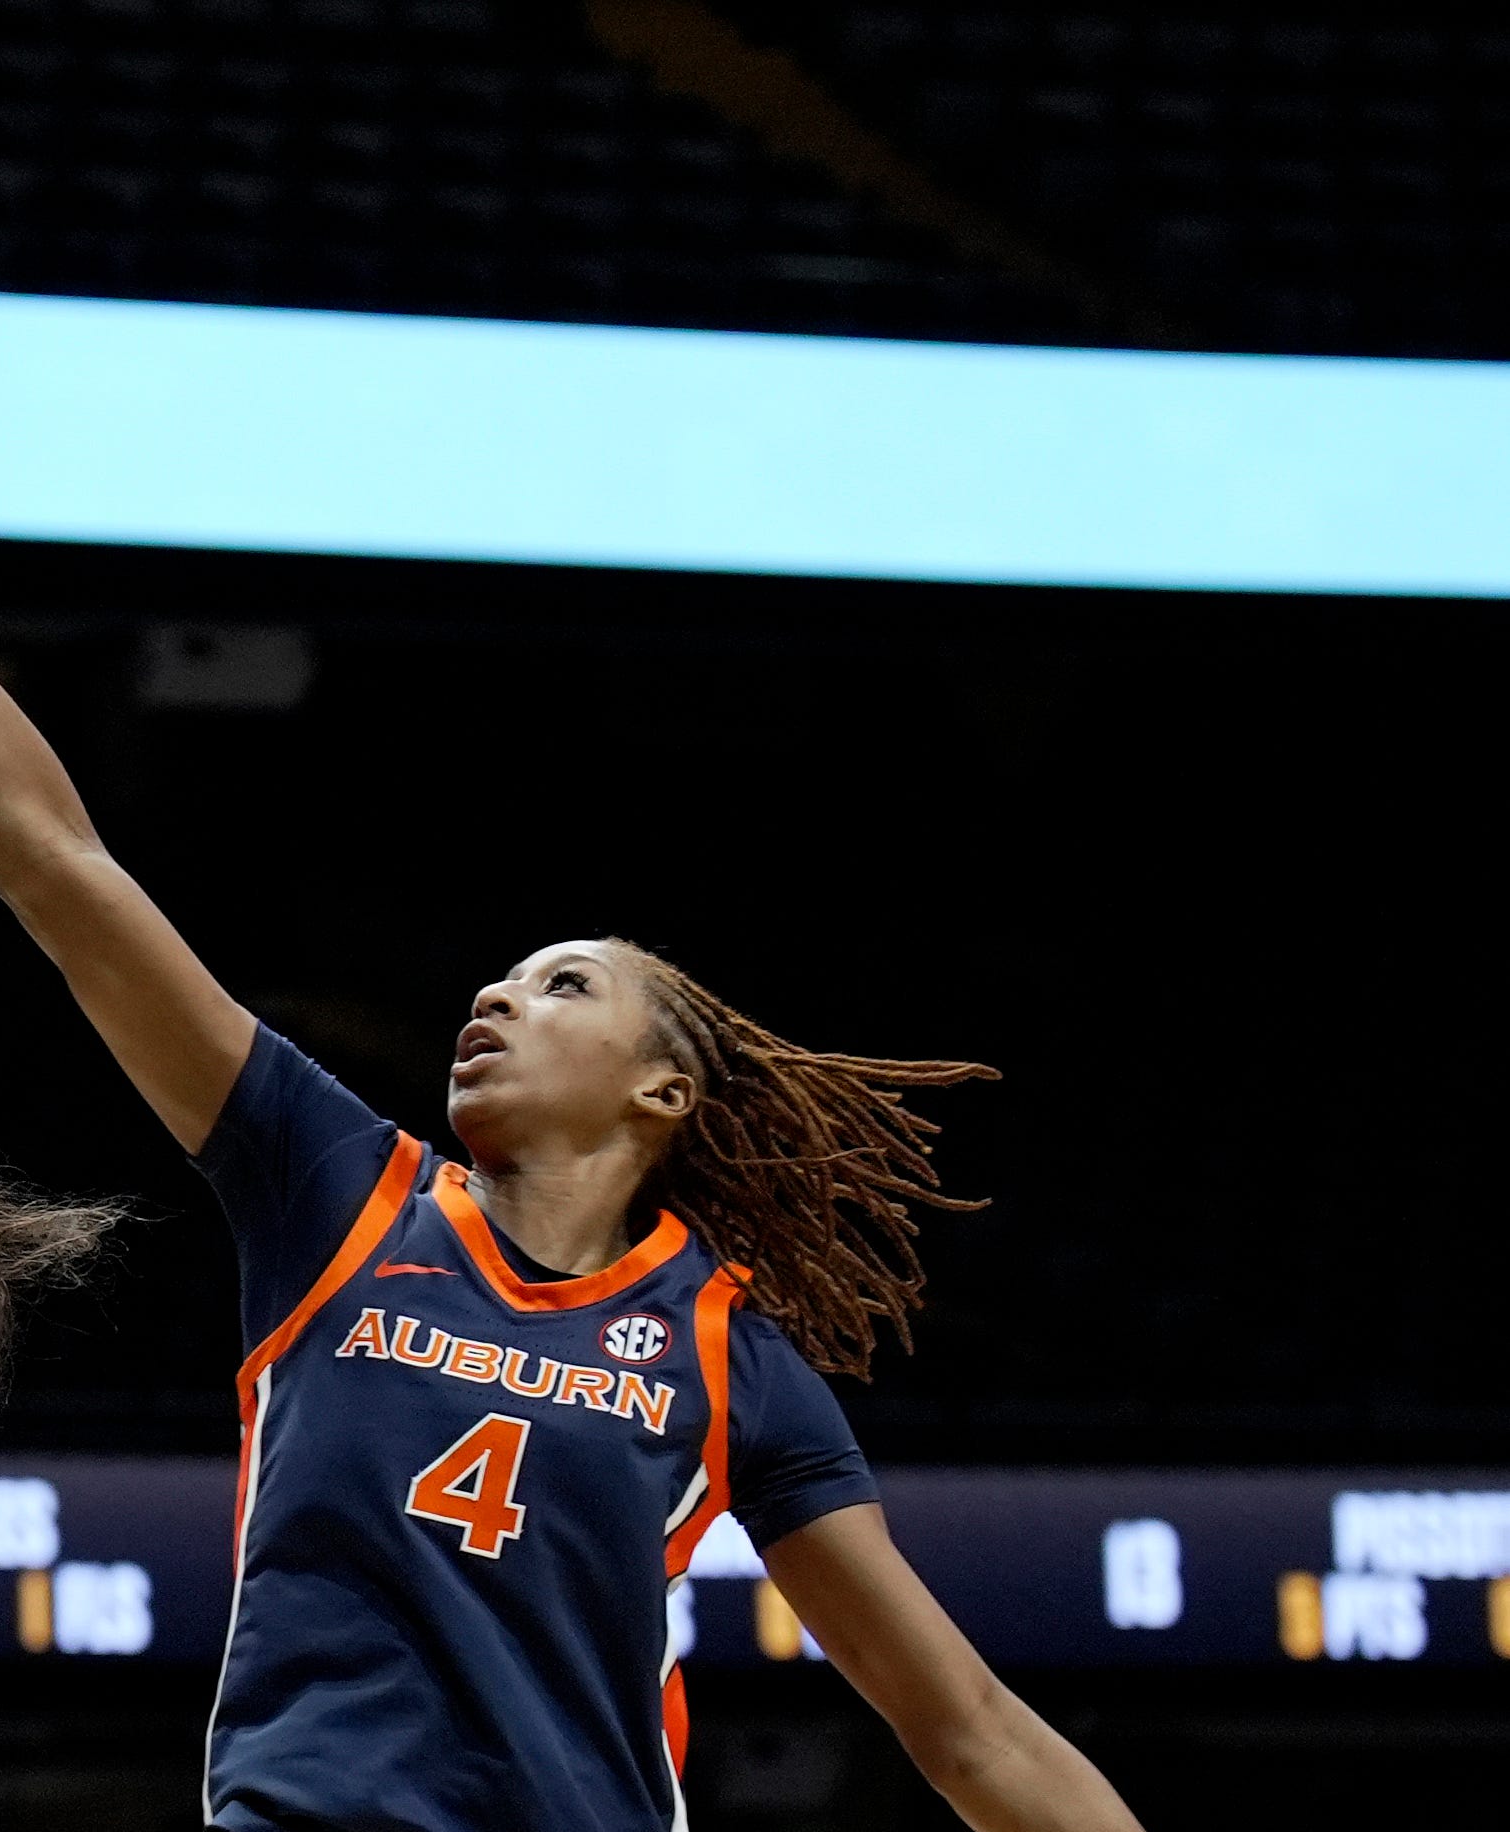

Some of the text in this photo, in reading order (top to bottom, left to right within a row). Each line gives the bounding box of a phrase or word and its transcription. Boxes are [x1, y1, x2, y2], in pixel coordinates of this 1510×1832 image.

[335, 1307, 676, 1436] AUBURN
[602, 1315, 670, 1362] SEC
[404, 1412, 531, 1560] 4
